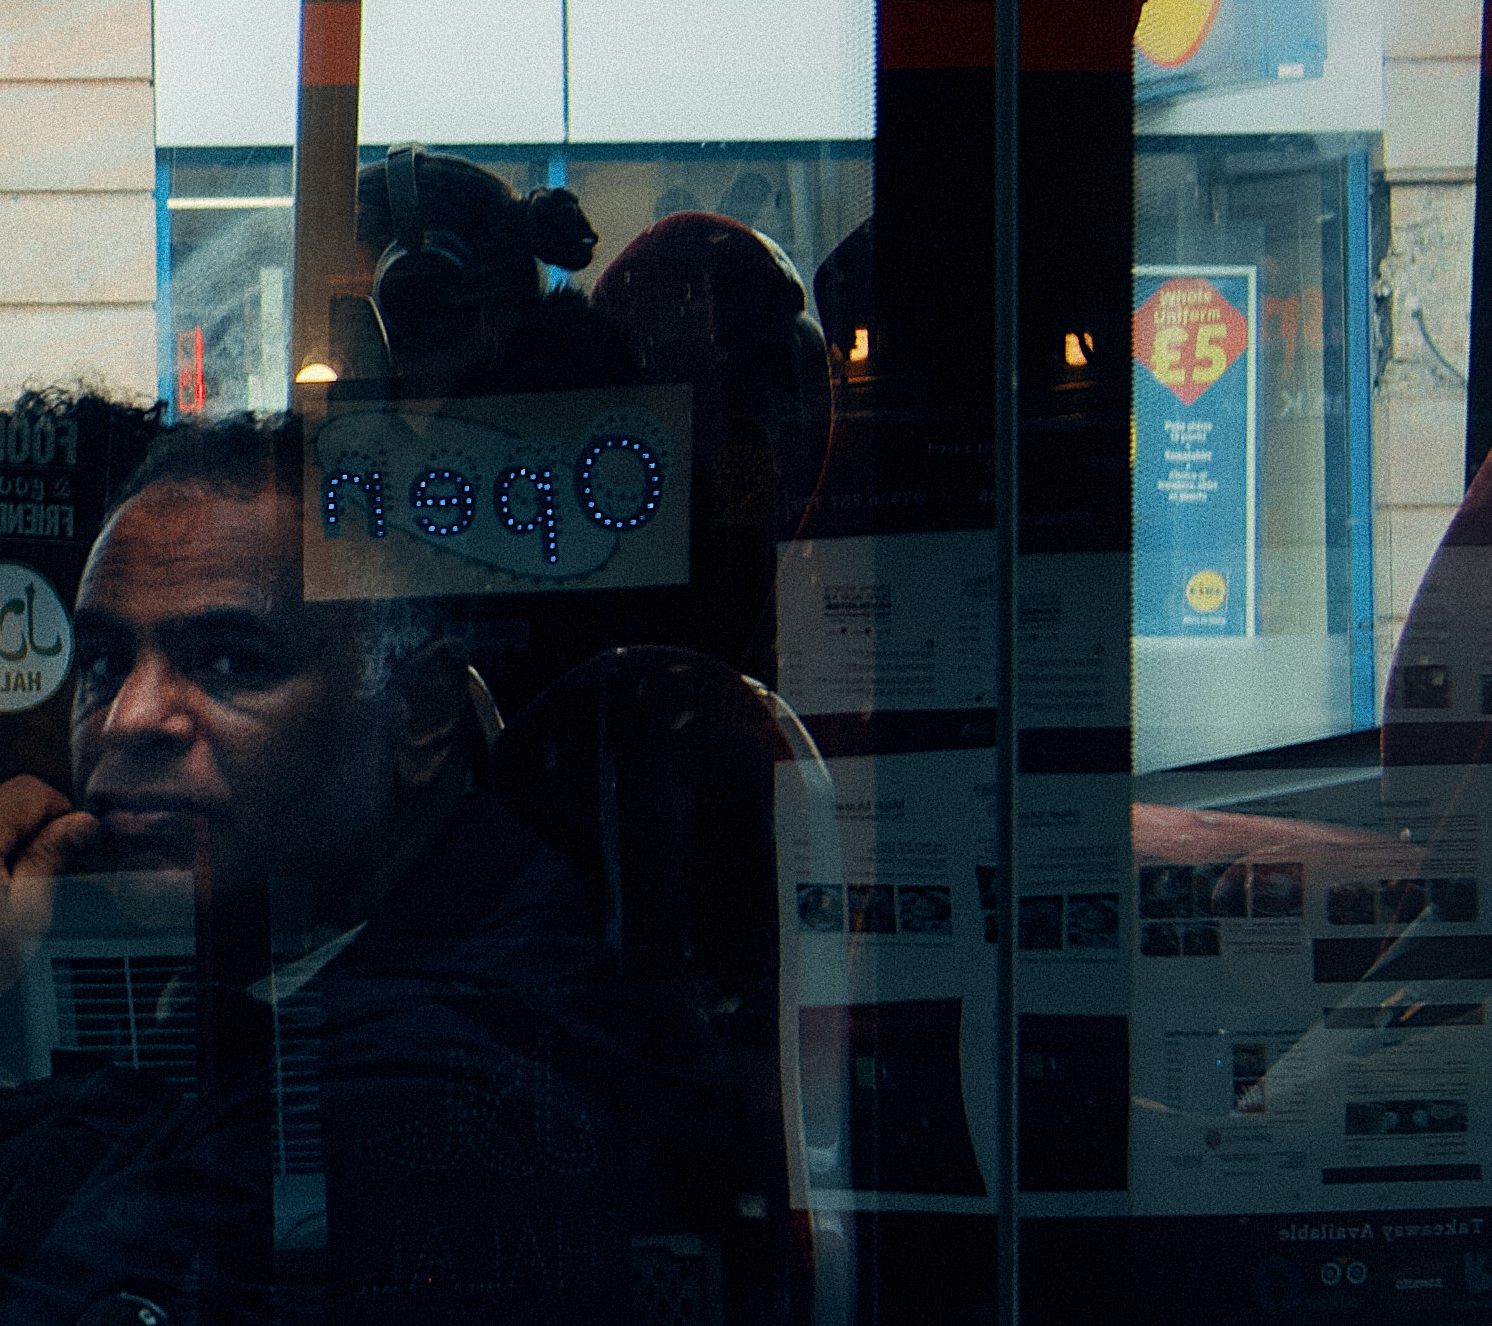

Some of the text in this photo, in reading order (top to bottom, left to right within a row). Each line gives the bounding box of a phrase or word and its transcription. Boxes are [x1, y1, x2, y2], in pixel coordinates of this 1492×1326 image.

[1159, 288, 1213, 306] Whole
[1153, 307, 1222, 327] Uniform
[1150, 322, 1228, 386] £5
